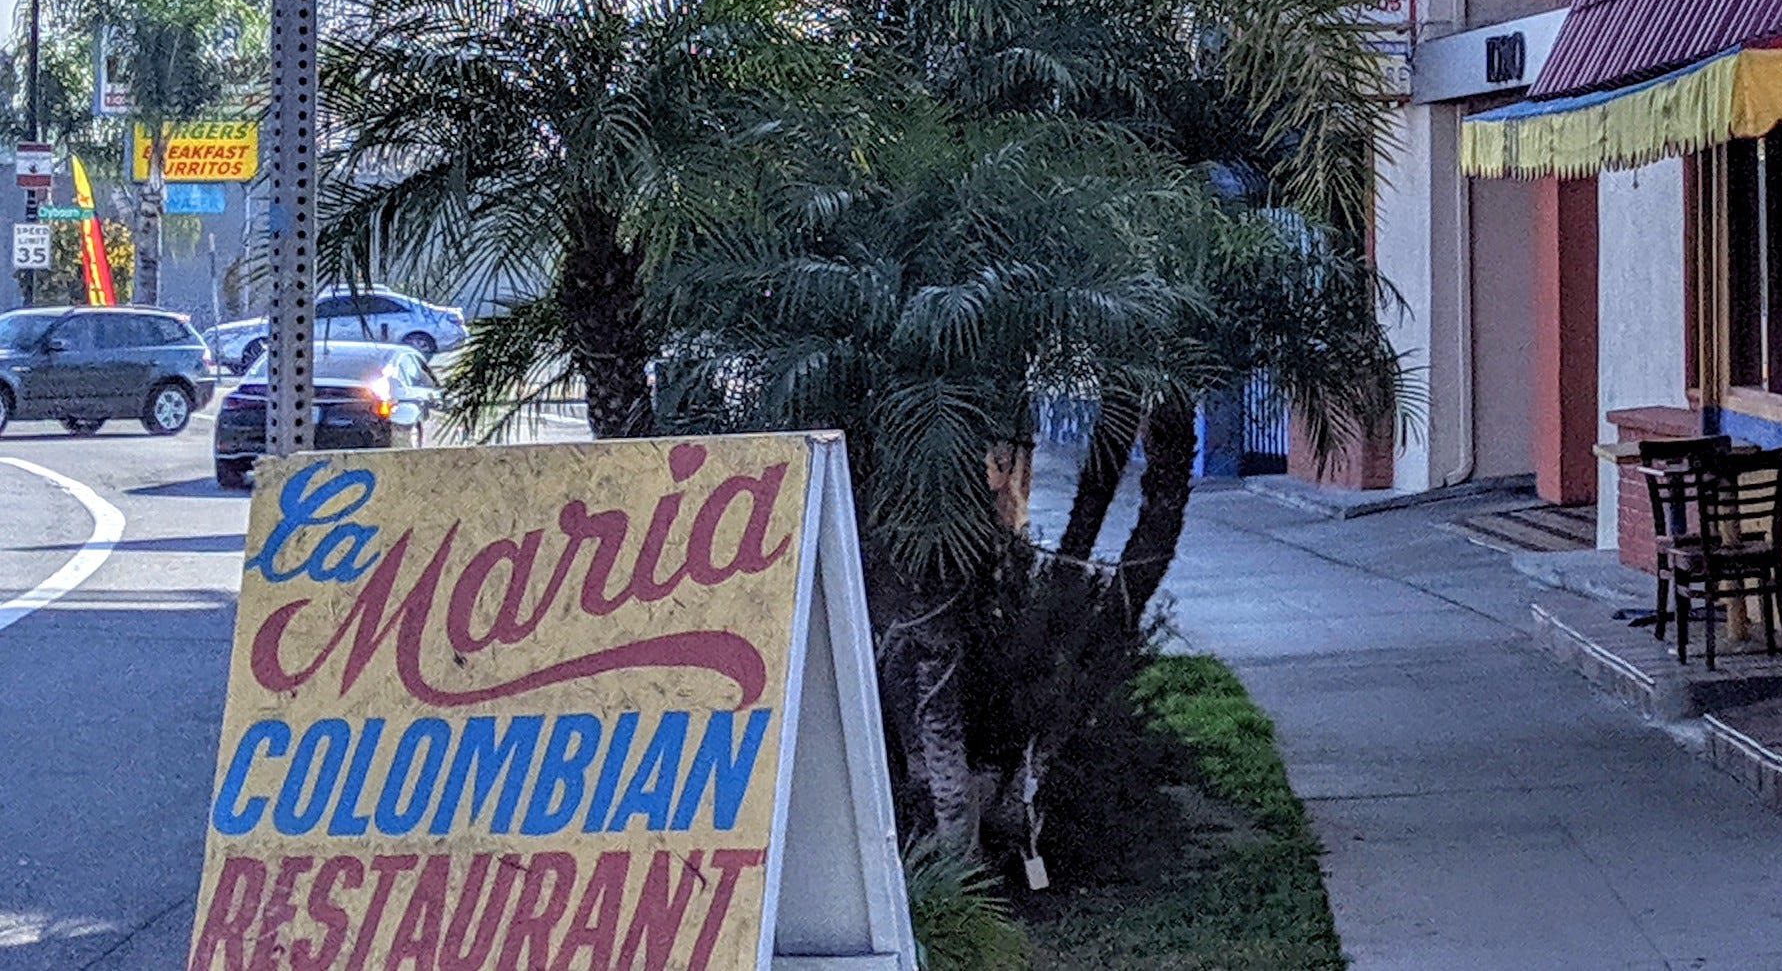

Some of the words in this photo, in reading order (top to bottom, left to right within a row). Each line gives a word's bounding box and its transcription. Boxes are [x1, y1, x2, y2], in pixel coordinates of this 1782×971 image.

[142, 145, 250, 160] BEAKFAST
[163, 161, 243, 176] URRITOS
[16, 247, 46, 264] 35
[246, 458, 382, 583] La
[250, 442, 793, 708] Maria
[211, 707, 773, 838] COLOMBIAN
[187, 847, 768, 971] RESTAURANT
